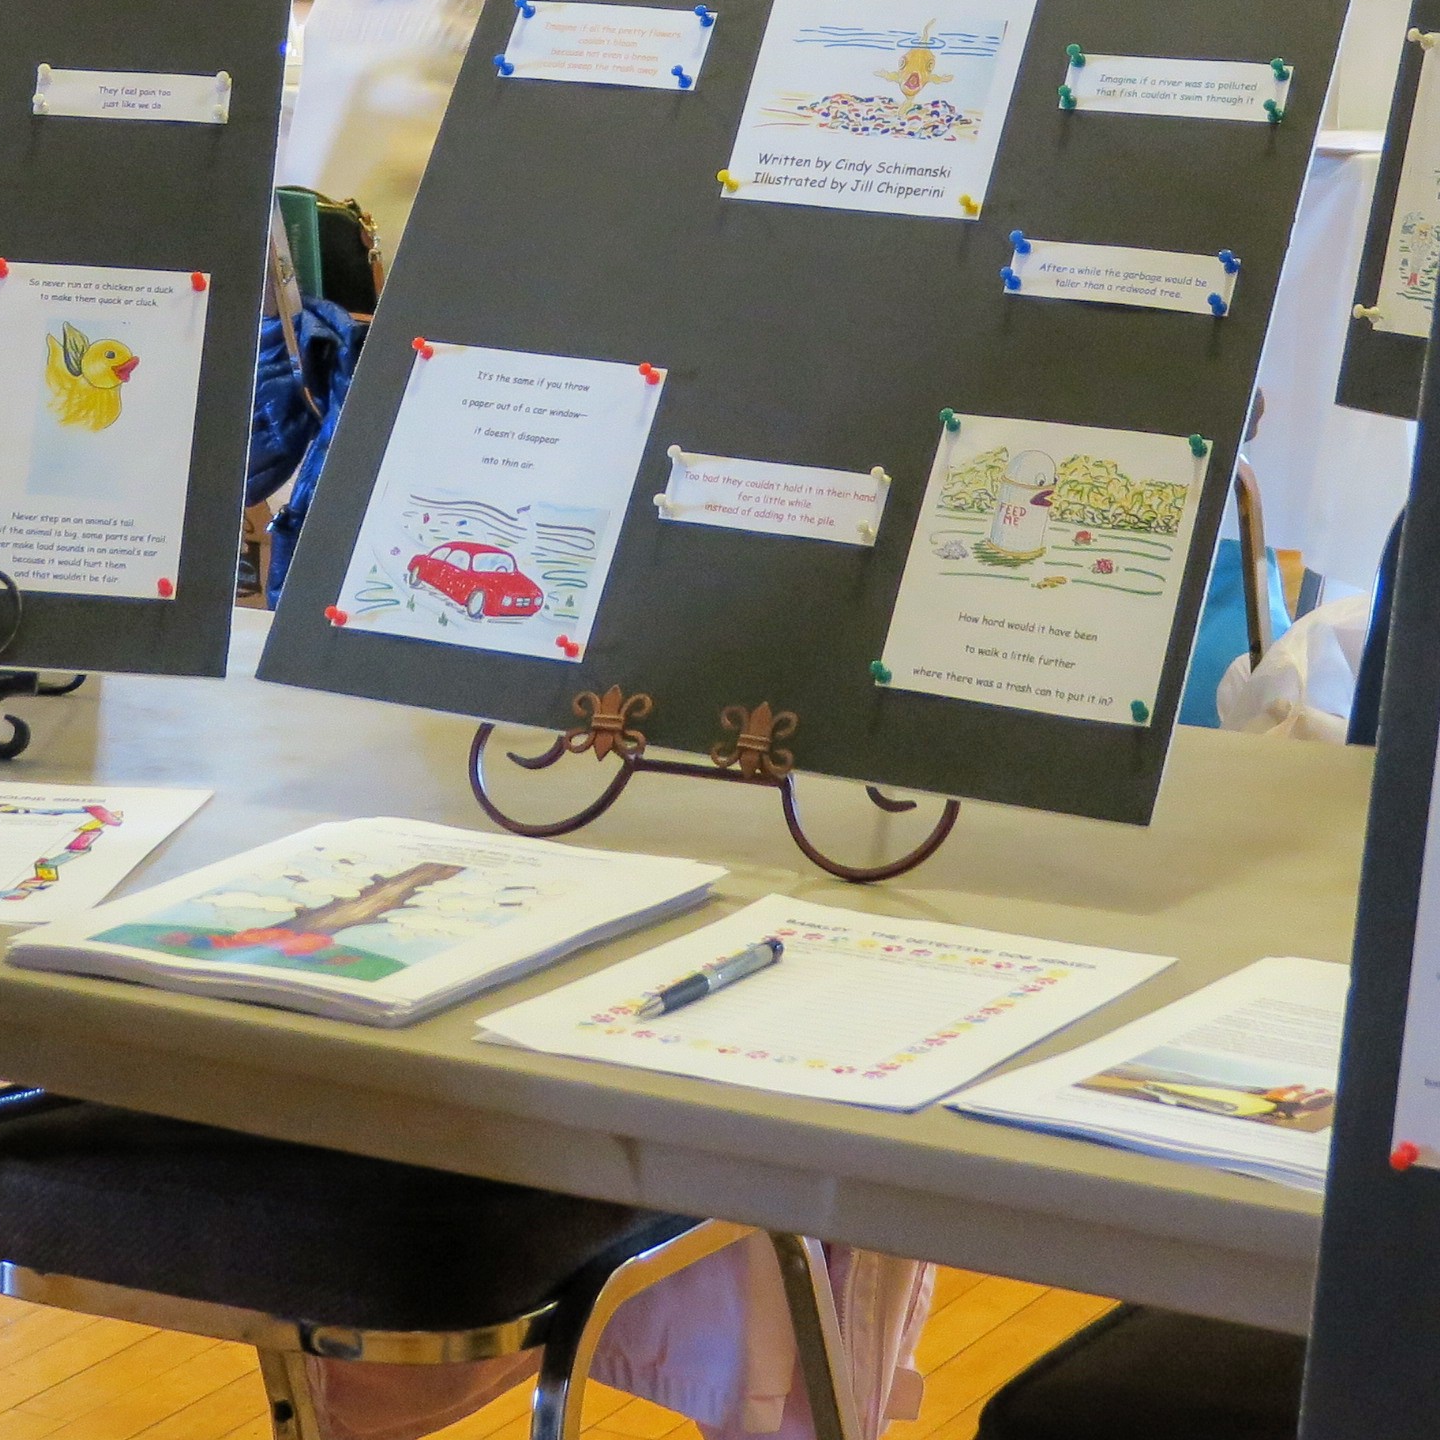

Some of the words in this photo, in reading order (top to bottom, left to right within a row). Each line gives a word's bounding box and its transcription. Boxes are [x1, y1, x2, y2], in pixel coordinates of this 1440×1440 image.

[98, 86, 118, 96] They
[121, 86, 138, 95] feel
[138, 89, 156, 97] pain
[1099, 74, 1137, 85] Imagine
[1139, 76, 1149, 84] if
[1217, 82, 1258, 92] polluted
[759, 153, 811, 166] Written
[815, 156, 832, 171] by
[835, 159, 873, 175] Cindy
[876, 162, 951, 177] Schimanski
[752, 172, 828, 188] Illustrated
[830, 178, 848, 193] by
[850, 179, 874, 191] Jill
[877, 181, 945, 198] Chipperini
[1039, 263, 1068, 272] After
[1077, 266, 1101, 275] while
[1105, 268, 1121, 277] the
[1122, 271, 1162, 283] garbage
[1165, 276, 1193, 285] would
[1195, 276, 1207, 287] be
[477, 370, 494, 380] It's
[495, 373, 511, 382] the
[512, 377, 535, 385] same
[537, 378, 545, 386] if
[546, 381, 562, 389] you
[565, 381, 590, 391] throw
[999, 502, 1026, 516] FEED
[1003, 515, 1019, 526] ME
[958, 612, 980, 623] How
[982, 615, 1006, 628] hard
[1007, 622, 1036, 632] would
[1037, 624, 1046, 633] it
[1048, 625, 1072, 637] have
[1074, 629, 1098, 641] been
